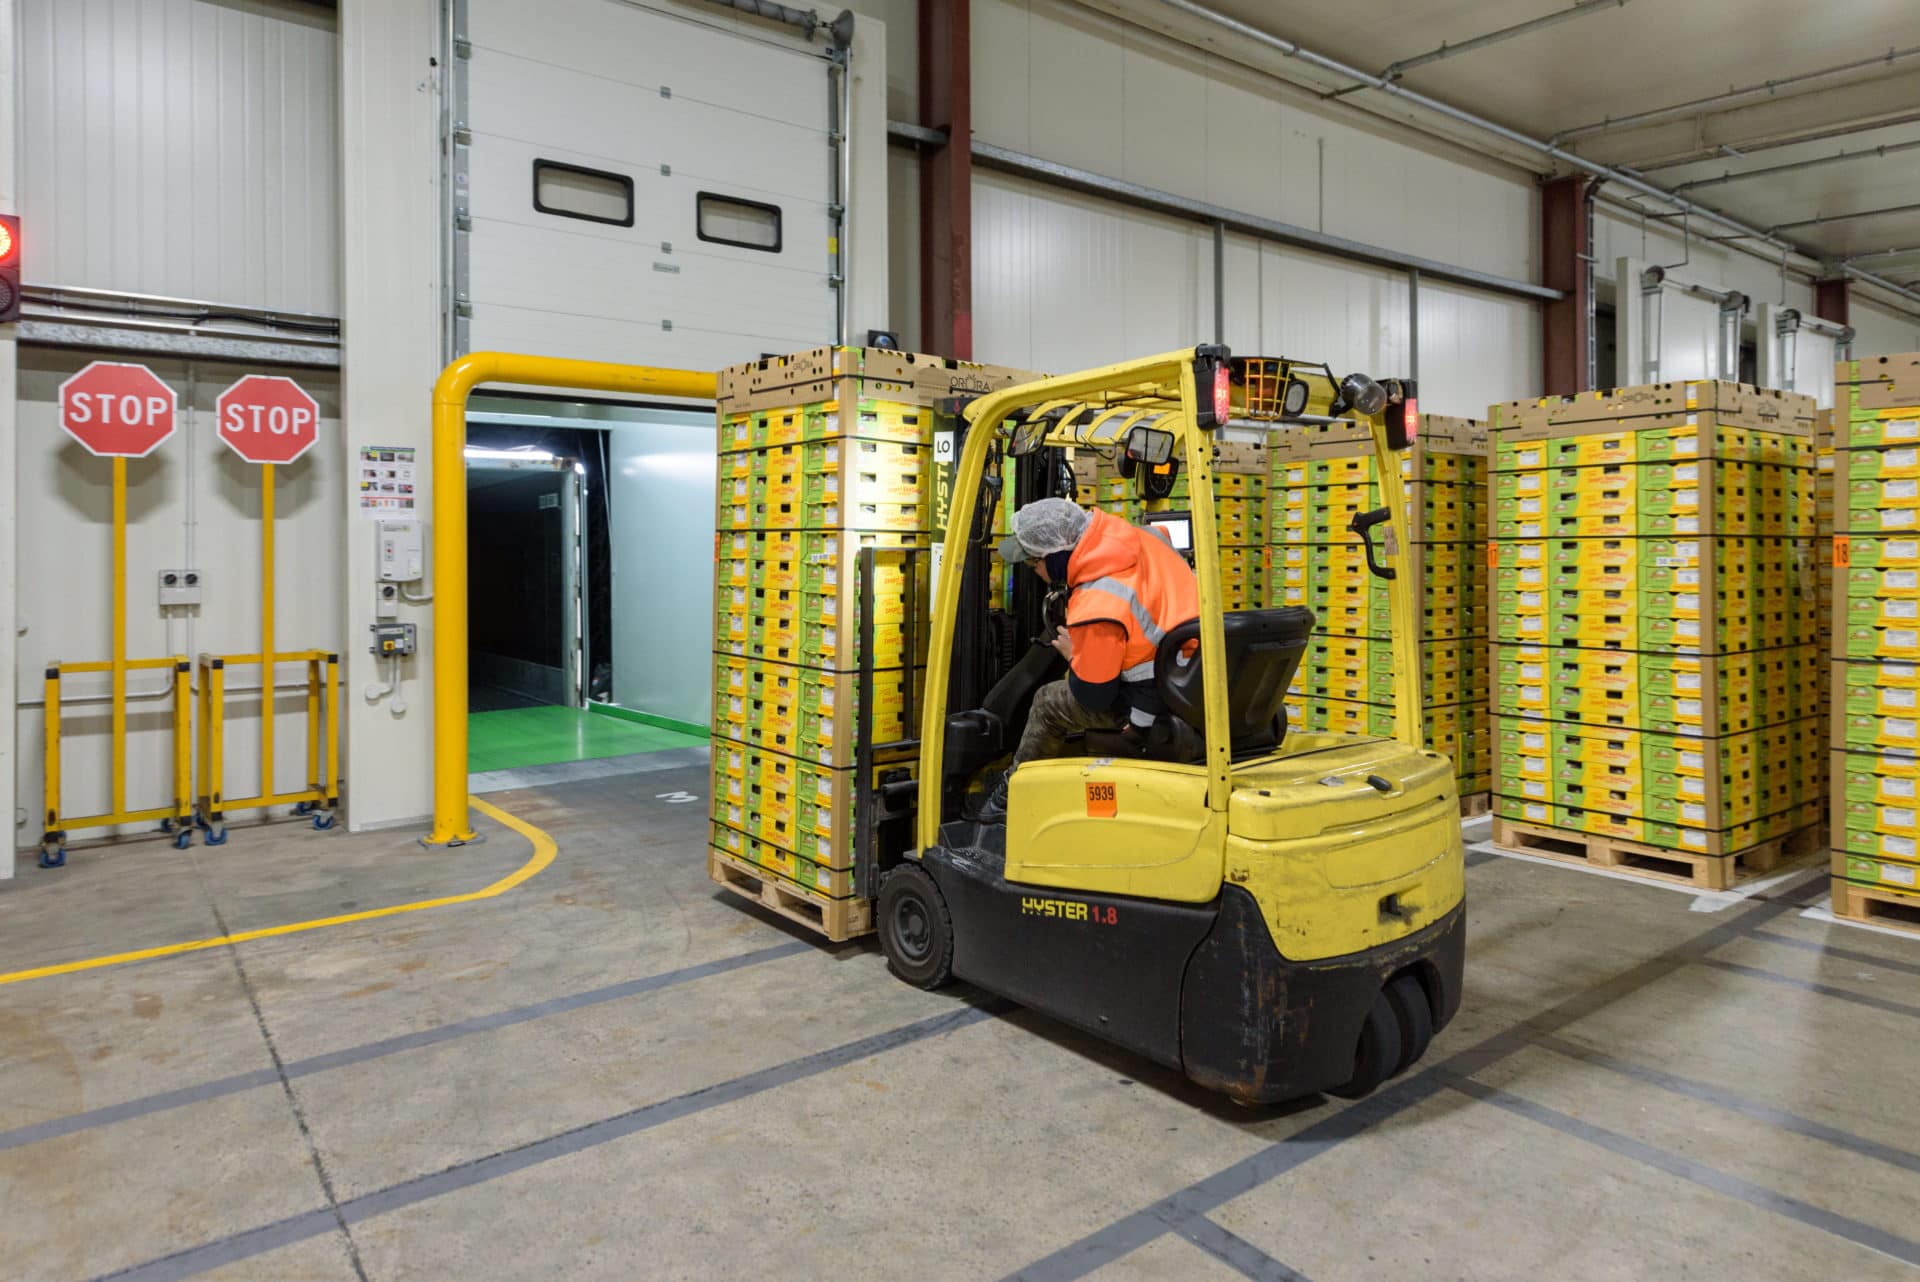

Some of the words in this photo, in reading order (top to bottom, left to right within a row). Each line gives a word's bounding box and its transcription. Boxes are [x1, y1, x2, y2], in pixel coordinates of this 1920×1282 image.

[69, 392, 168, 426] STOP
[225, 403, 311, 435] STOP
[936, 461, 949, 531] HYST
[1089, 785, 1114, 801] 5939
[1022, 897, 1088, 921] HYSTER
[1092, 904, 1118, 925] 1.8
